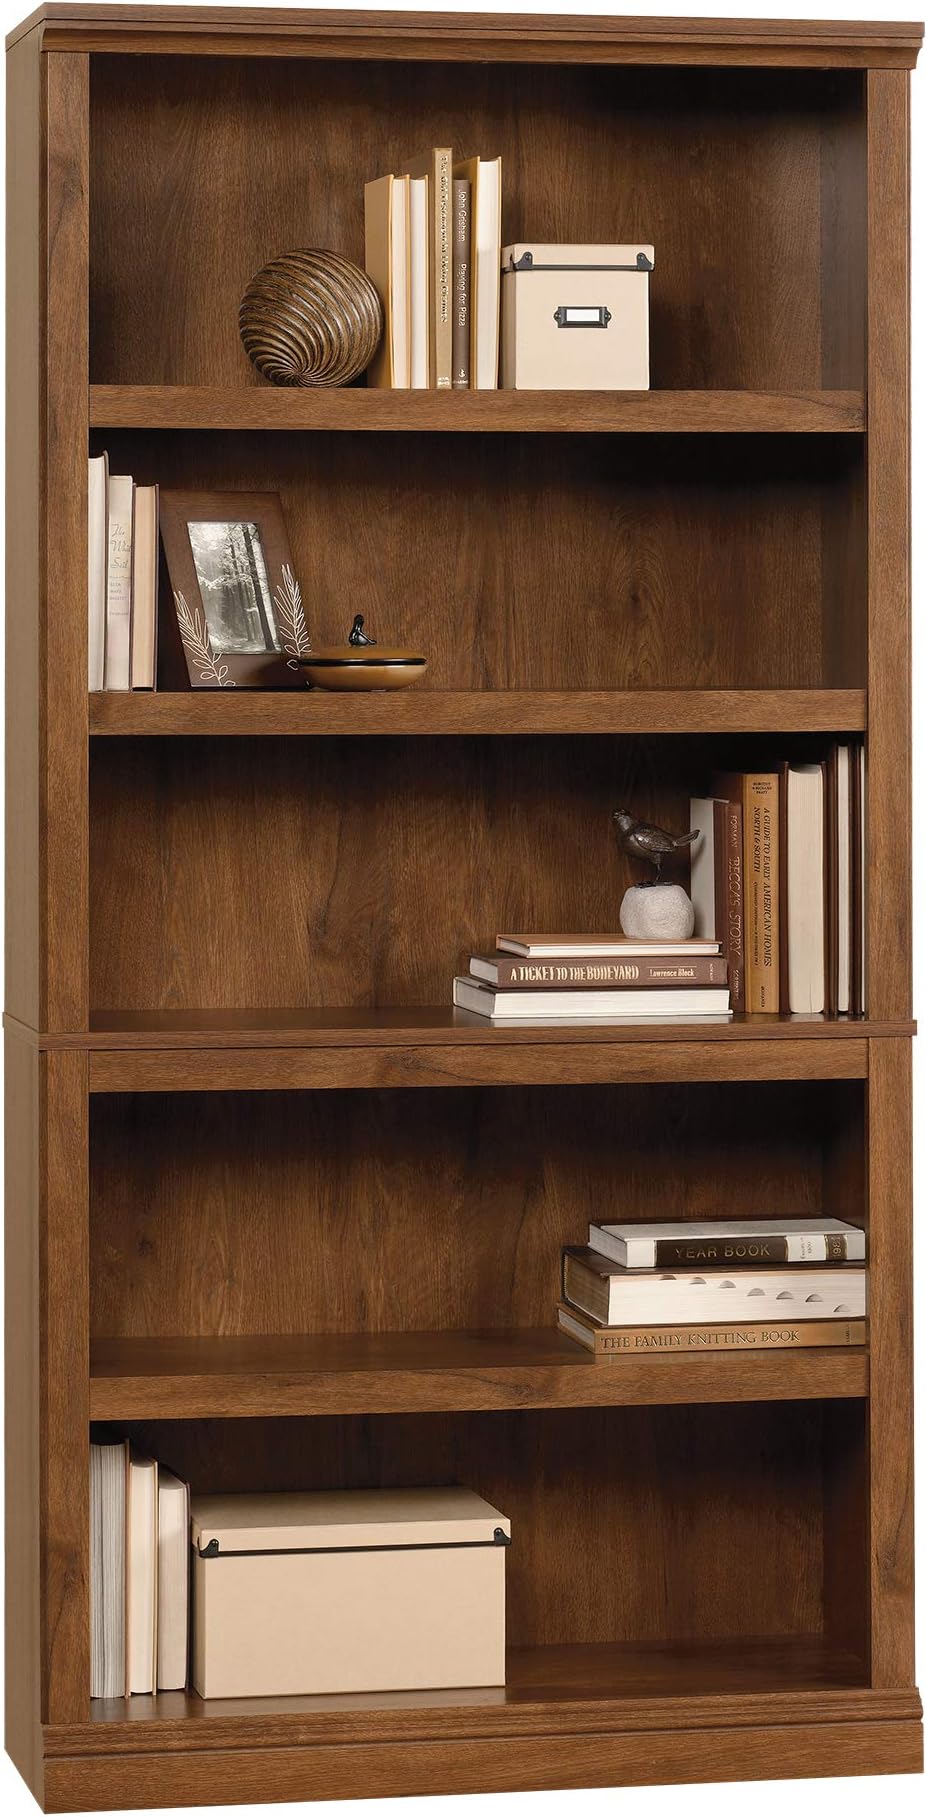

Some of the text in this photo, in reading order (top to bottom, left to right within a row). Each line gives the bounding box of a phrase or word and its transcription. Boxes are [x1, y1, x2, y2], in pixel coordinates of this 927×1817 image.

[458, 189, 467, 242] John Grisham
[457, 263, 467, 328] Playing for Pizza
[730, 815, 738, 848] FORMAN
[753, 807, 761, 836] NORTH
[763, 815, 771, 841] GUIDE
[753, 844, 761, 873] SOUTH
[763, 842, 771, 854] TO
[763, 855, 771, 880] EARLY
[728, 856, 741, 956] BECCA'S STORY
[763, 882, 772, 930] AMERICAN
[763, 934, 772, 967] HOMES
[510, 968, 517, 981] A
[518, 966, 555, 981] TICKET
[556, 966, 568, 981] TO
[569, 966, 586, 981] THE
[649, 967, 695, 977] Lawrence Block
[675, 1243, 770, 1258] YEAR BOOK
[601, 1330, 801, 1349] THE FAMILY KNITTING BOOK
